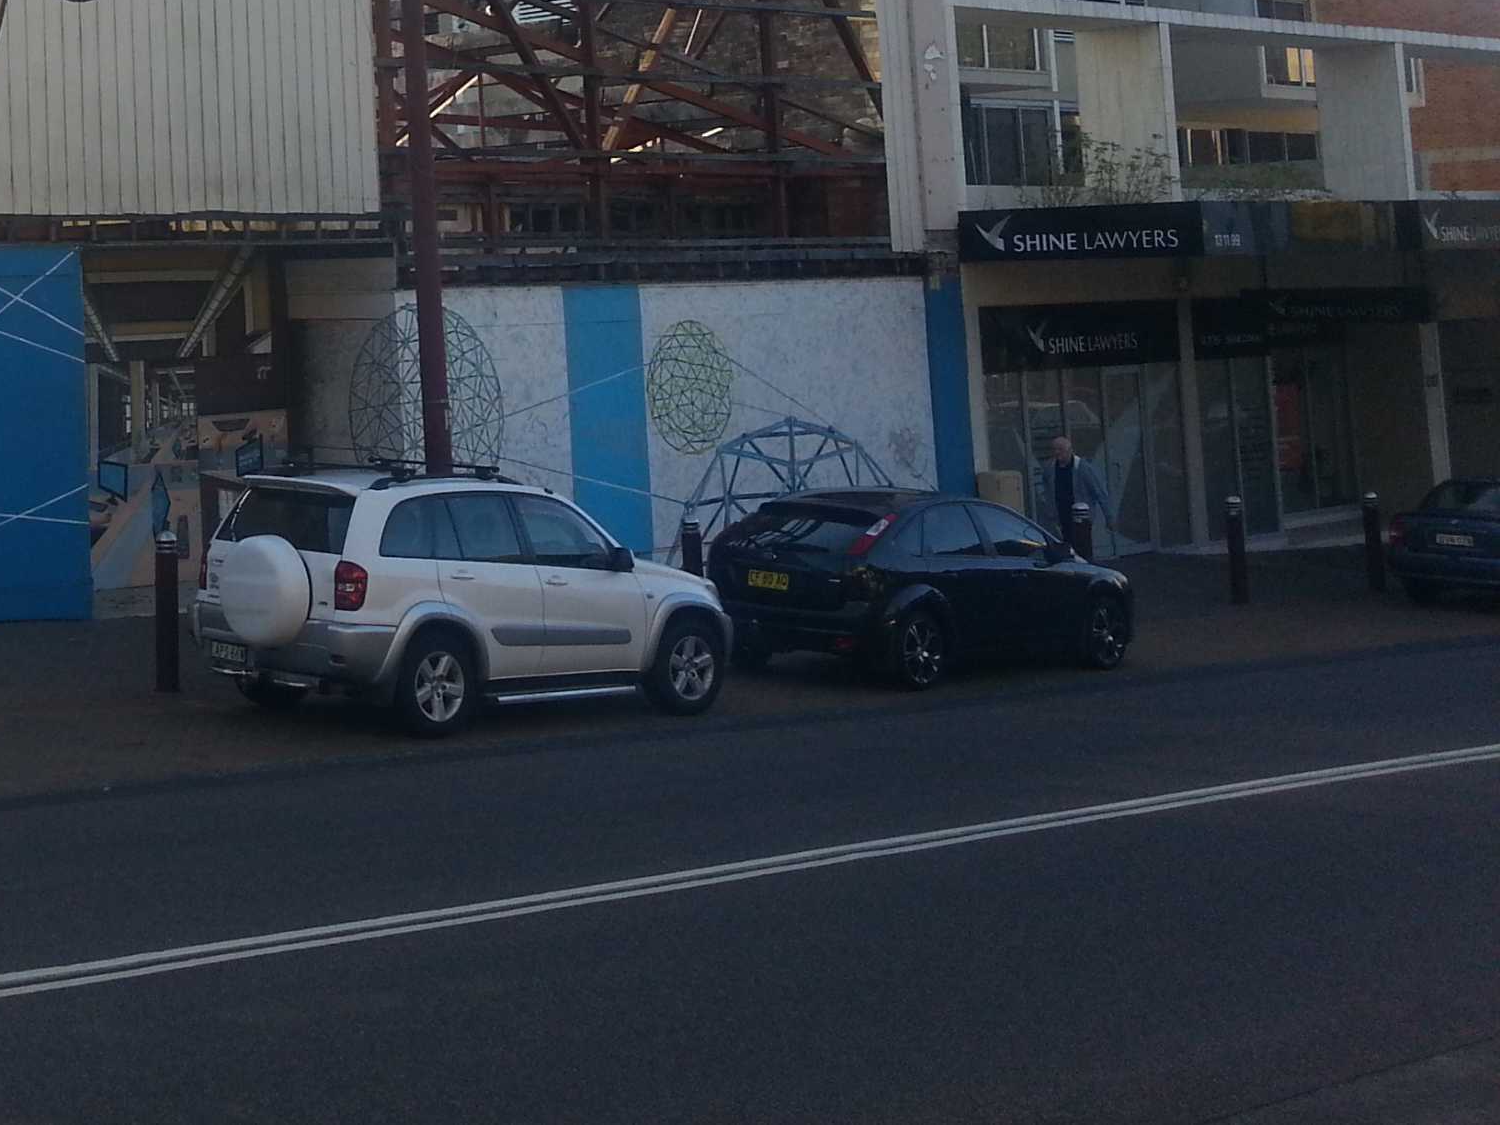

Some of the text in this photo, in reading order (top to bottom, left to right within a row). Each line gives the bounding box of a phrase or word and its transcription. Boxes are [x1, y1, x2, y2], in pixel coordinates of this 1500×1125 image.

[1012, 228, 1180, 253] SHINE LAWYERS
[1440, 226, 1469, 242] SHINE
[1048, 332, 1139, 355] SHINE LAWYERS
